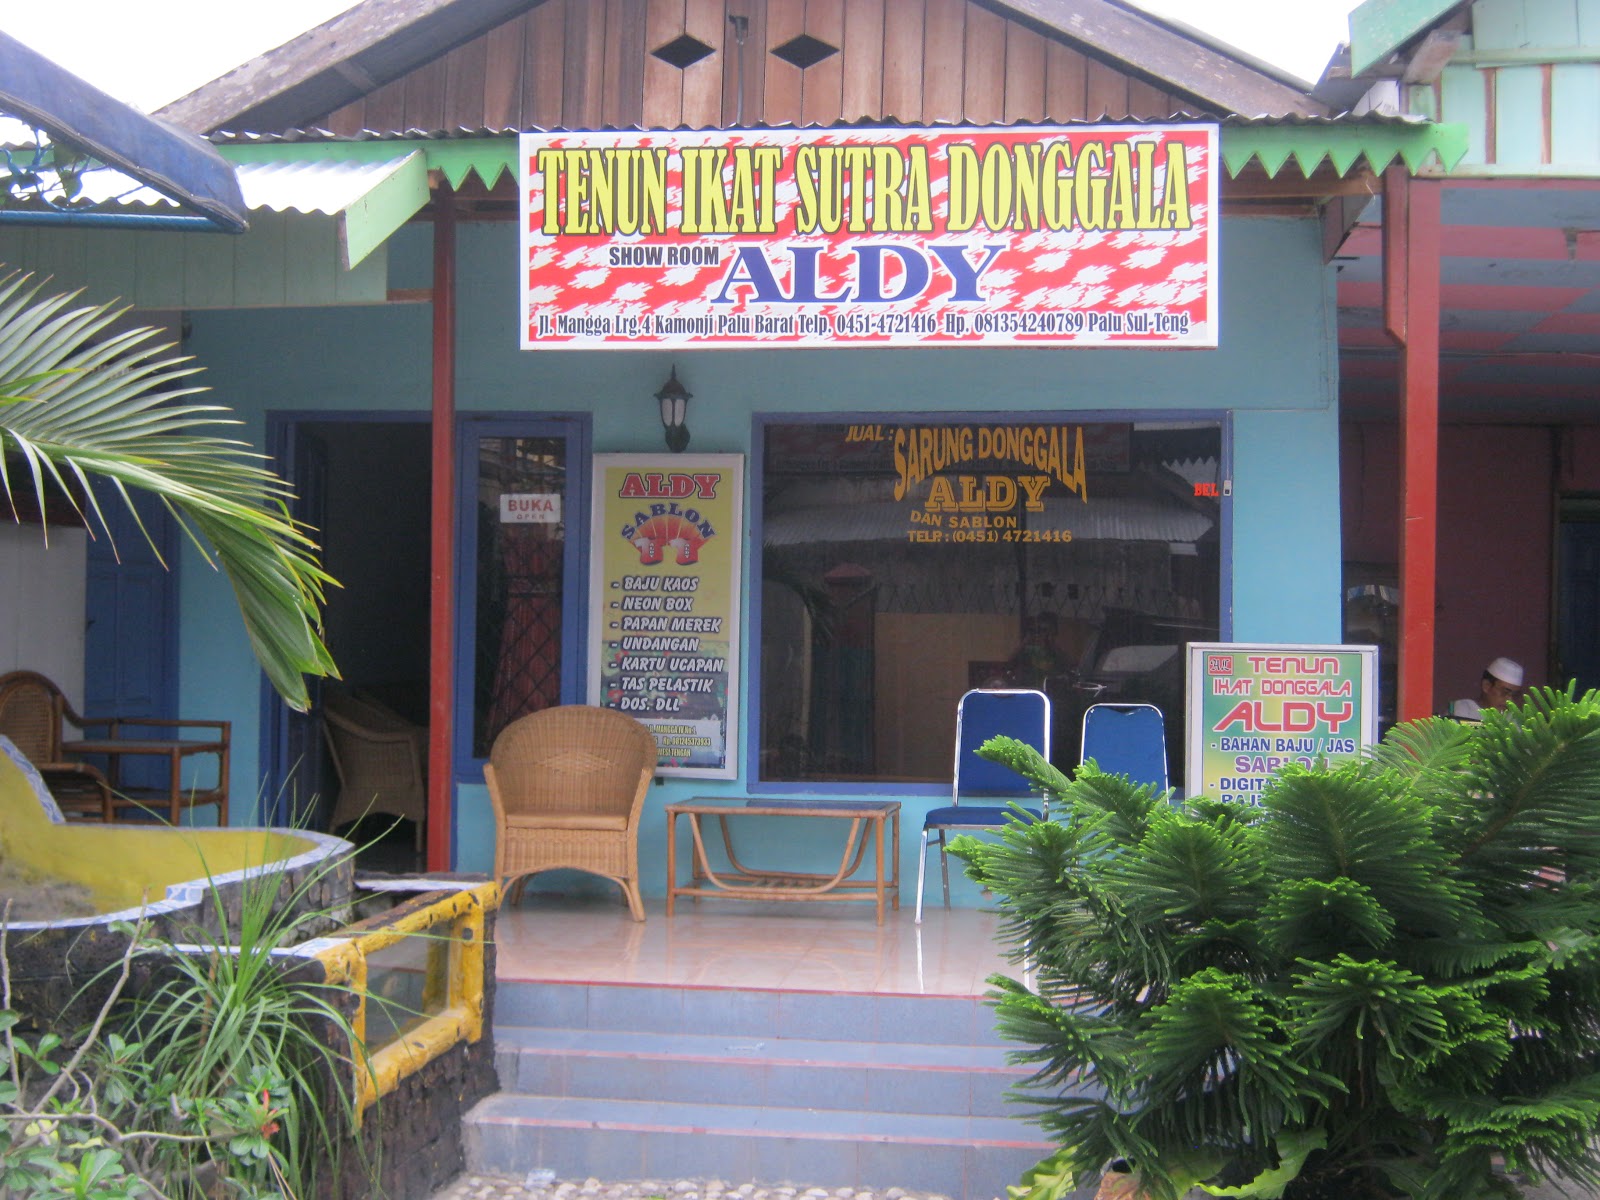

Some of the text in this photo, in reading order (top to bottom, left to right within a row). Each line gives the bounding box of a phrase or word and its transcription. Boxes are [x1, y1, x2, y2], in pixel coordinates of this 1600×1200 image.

[537, 140, 1193, 236] TENUN IKAT SUTRA DONGGALA
[609, 246, 719, 266] SHOW ROOM
[710, 244, 1006, 303] ALDY
[538, 312, 1189, 336] Jl. Mangga Lrg.4 Kamonji Palu Barat Telp. 0451-4721416 Hp. 081354240789 Palu Sul-Teng
[845, 425, 885, 442] JUAL
[893, 426, 1087, 504] SARUNG DONGGALA
[619, 473, 721, 499] ALDY
[924, 475, 1051, 513] ALDY
[1194, 483, 1219, 497] BEL
[508, 499, 553, 512] BUKA
[621, 502, 715, 540] SABLON
[910, 510, 1017, 529] DAN SABLON
[952, 530, 999, 543] (0451)
[1002, 530, 1072, 543] 4721416
[623, 576, 660, 591] BAJU
[663, 577, 699, 592] KAOS
[622, 596, 661, 611] NEON
[665, 596, 694, 611] BOX
[622, 616, 668, 631] PAPAN
[671, 617, 722, 633] MEREK
[621, 636, 700, 652] UNDANGAN
[621, 656, 666, 671] KARTU
[669, 658, 724, 673] UCAPAN
[1248, 656, 1339, 674] TENUN
[621, 677, 645, 691] TAS
[648, 677, 714, 693] PELASTIK
[1261, 679, 1352, 697] DONGGALA
[655, 697, 681, 711] DLL
[1212, 701, 1353, 733] ALDY
[1220, 737, 1271, 751] BAHAN
[1275, 738, 1313, 752] BAJU
[1327, 739, 1355, 753] JAS
[1220, 777, 1279, 790] DIGIT
